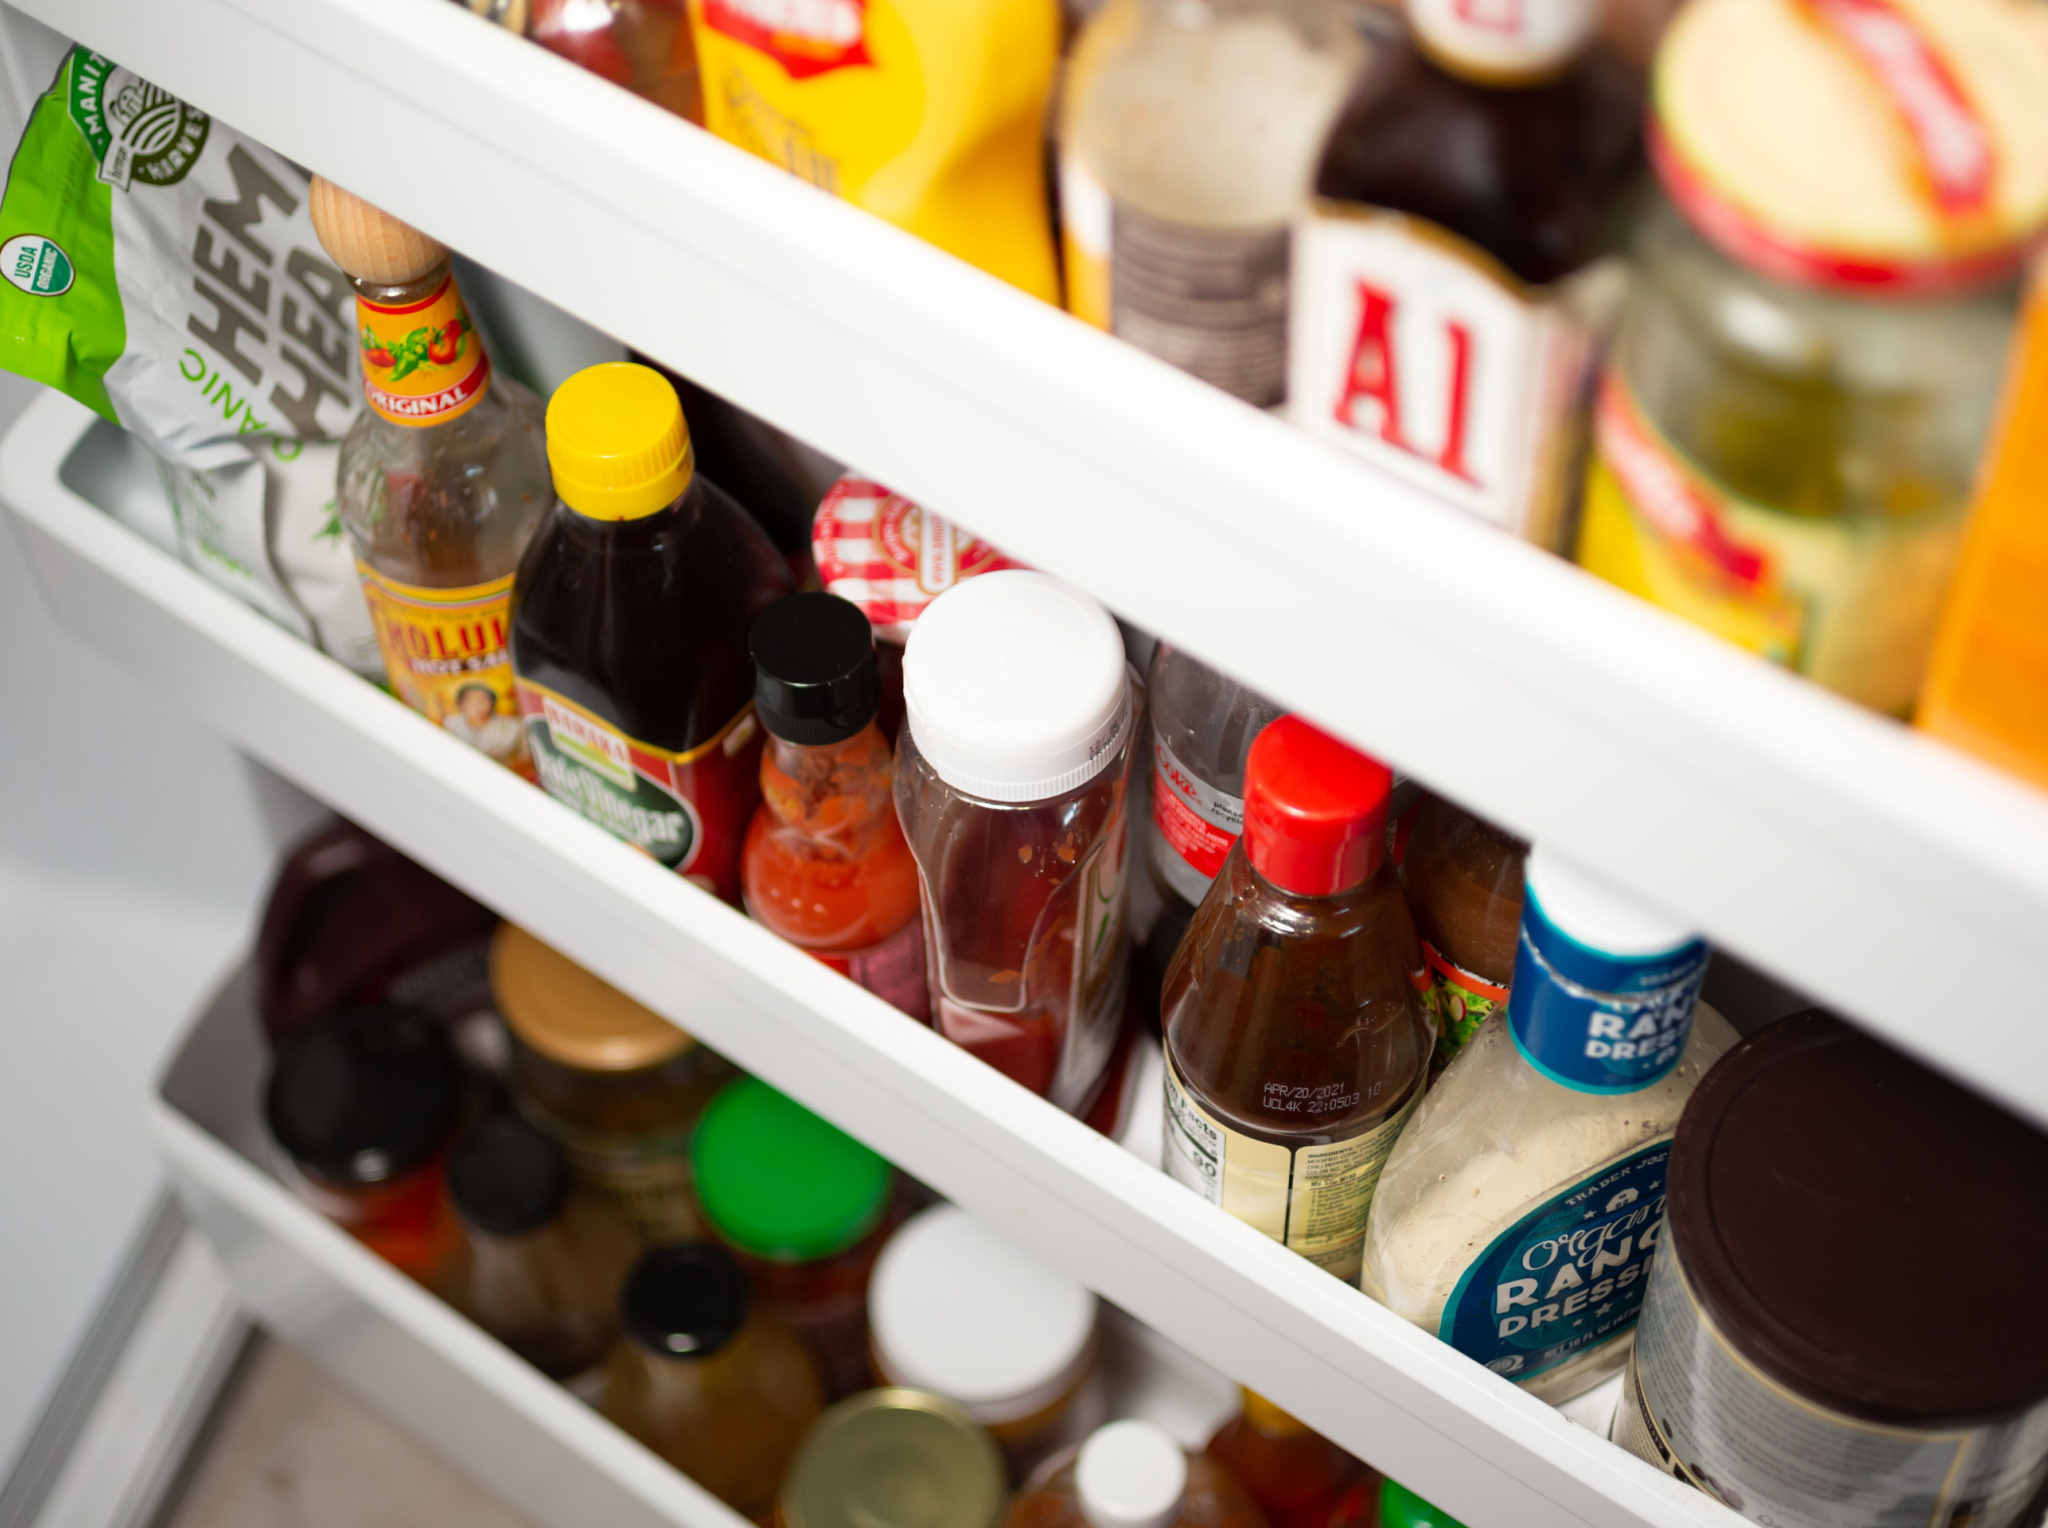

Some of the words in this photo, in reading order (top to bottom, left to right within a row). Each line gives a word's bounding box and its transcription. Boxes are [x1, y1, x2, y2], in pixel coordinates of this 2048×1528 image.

[14, 246, 38, 279] USDA
[36, 247, 58, 290] ORGANIC
[1264, 1082, 1345, 1099] APR/20/2021
[1564, 1166, 1632, 1207] TRADER
